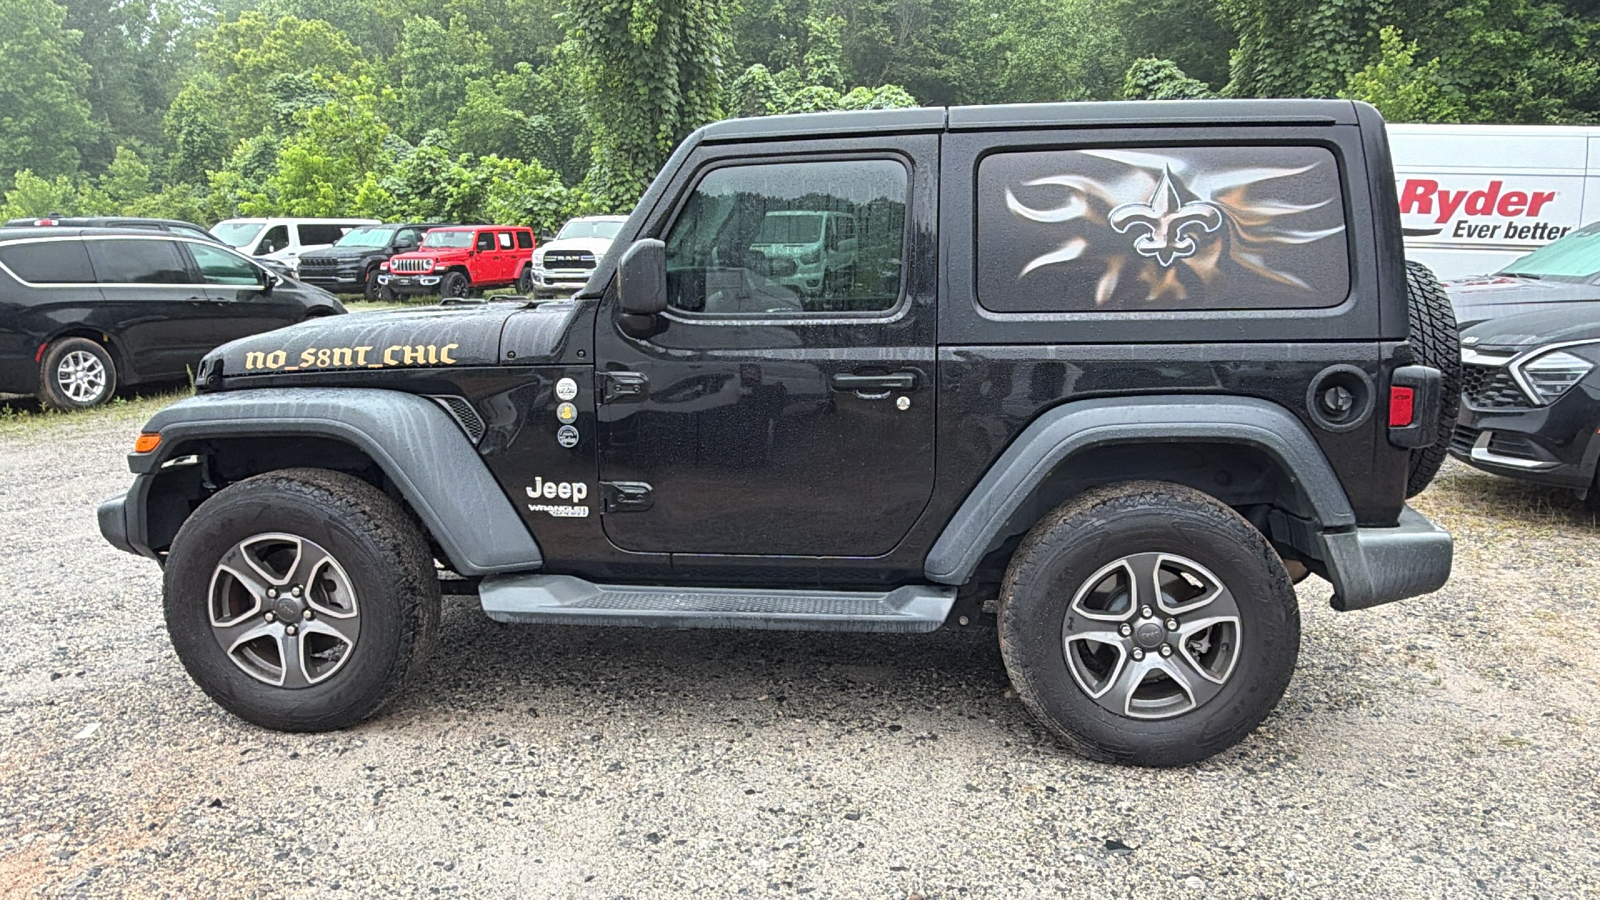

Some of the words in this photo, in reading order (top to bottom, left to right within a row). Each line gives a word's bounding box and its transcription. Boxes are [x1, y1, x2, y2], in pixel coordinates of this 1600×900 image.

[1400, 179, 1556, 224] Ryder
[1452, 220, 1501, 239] Ever
[1503, 221, 1572, 240] better
[526, 476, 588, 503] Jeep
